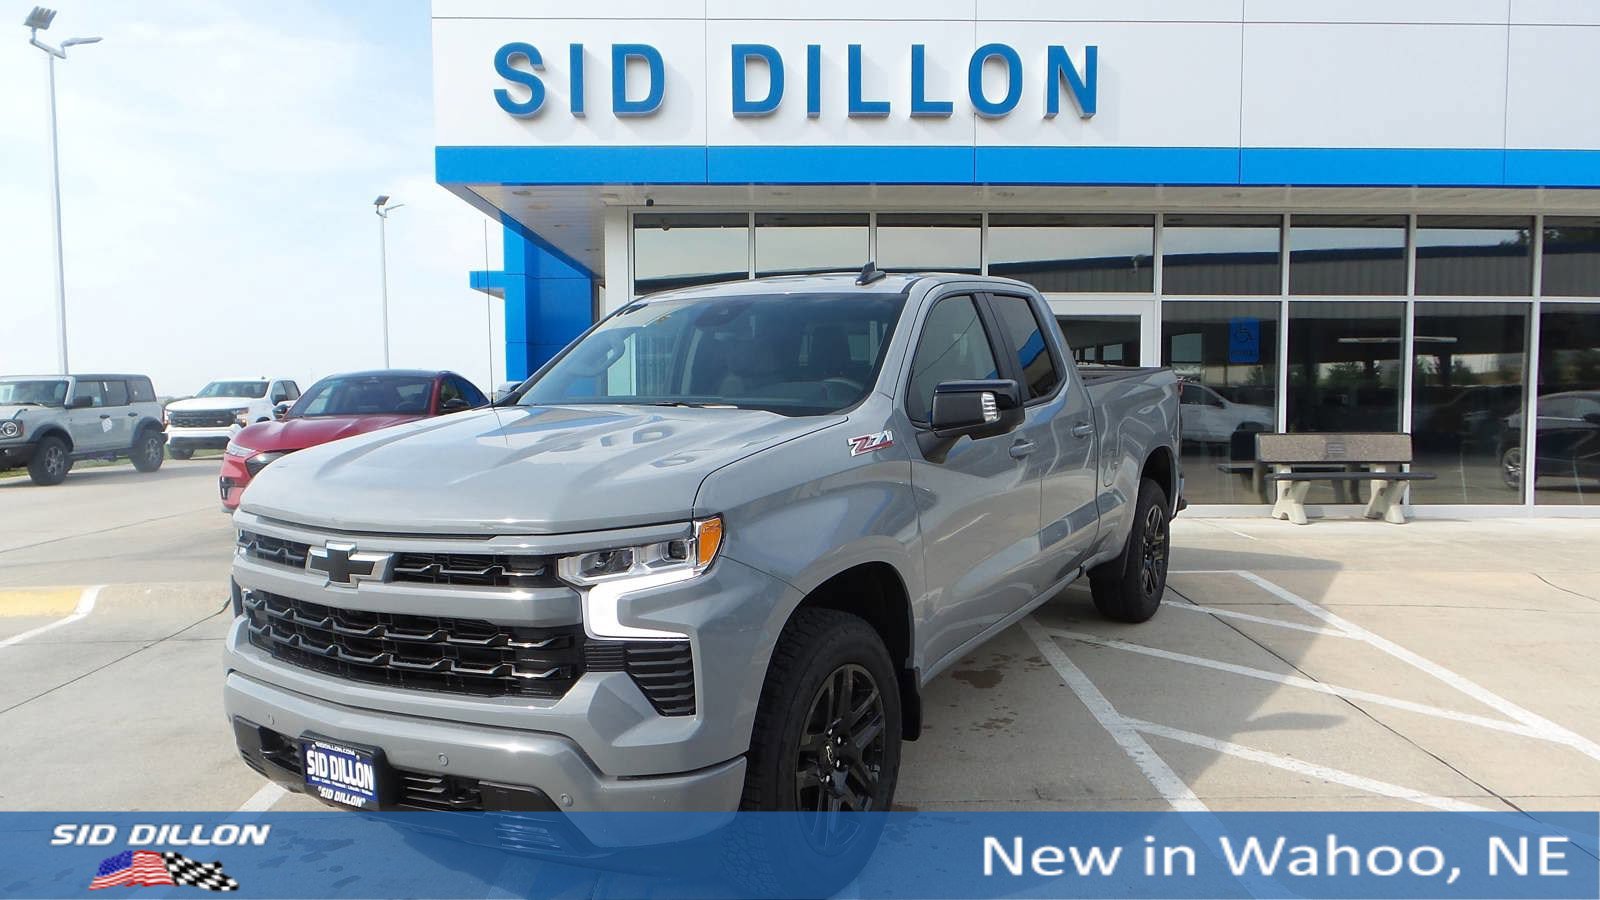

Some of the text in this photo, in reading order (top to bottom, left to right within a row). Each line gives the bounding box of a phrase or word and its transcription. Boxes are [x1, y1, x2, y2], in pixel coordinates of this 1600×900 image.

[493, 42, 1099, 119] SID DILLON
[847, 430, 895, 457] Z71
[306, 750, 328, 778] SID
[329, 755, 374, 790] DILLON
